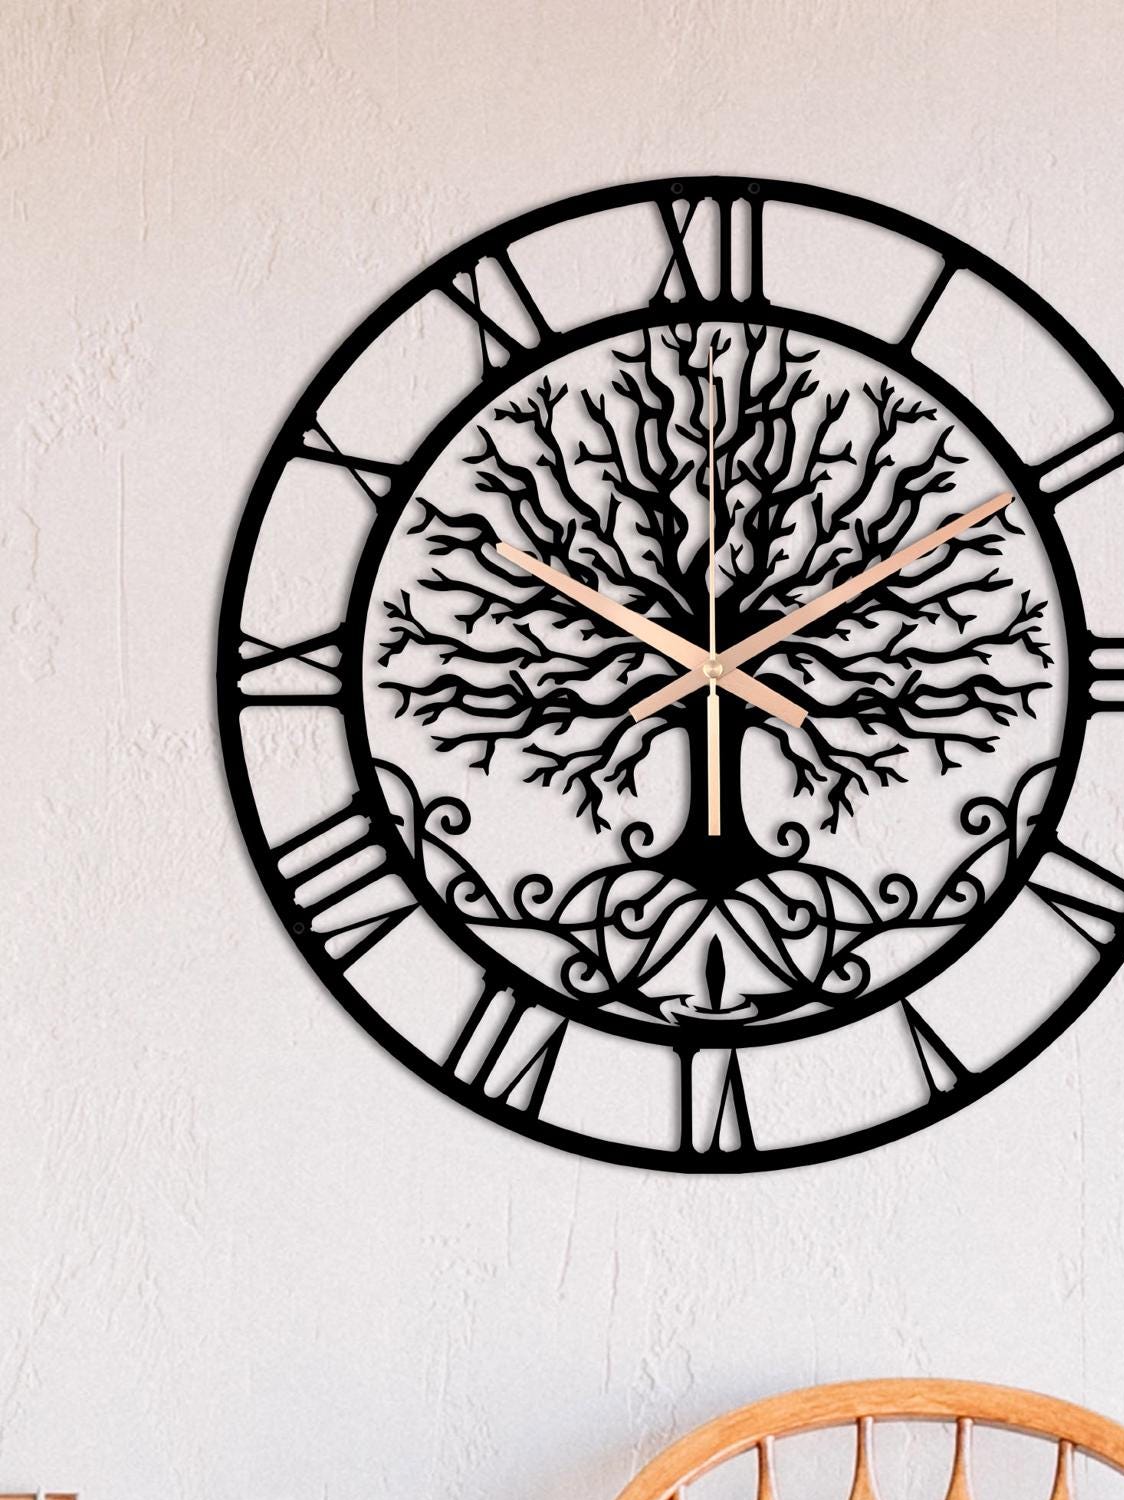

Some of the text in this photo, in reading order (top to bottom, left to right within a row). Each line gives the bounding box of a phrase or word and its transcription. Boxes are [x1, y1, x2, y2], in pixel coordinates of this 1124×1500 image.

[650, 194, 772, 306] XII
[429, 244, 563, 383] XI
[288, 410, 409, 515] X
[237, 621, 345, 716] IX
[439, 969, 570, 1122] VII
[671, 1047, 758, 1154] VI
